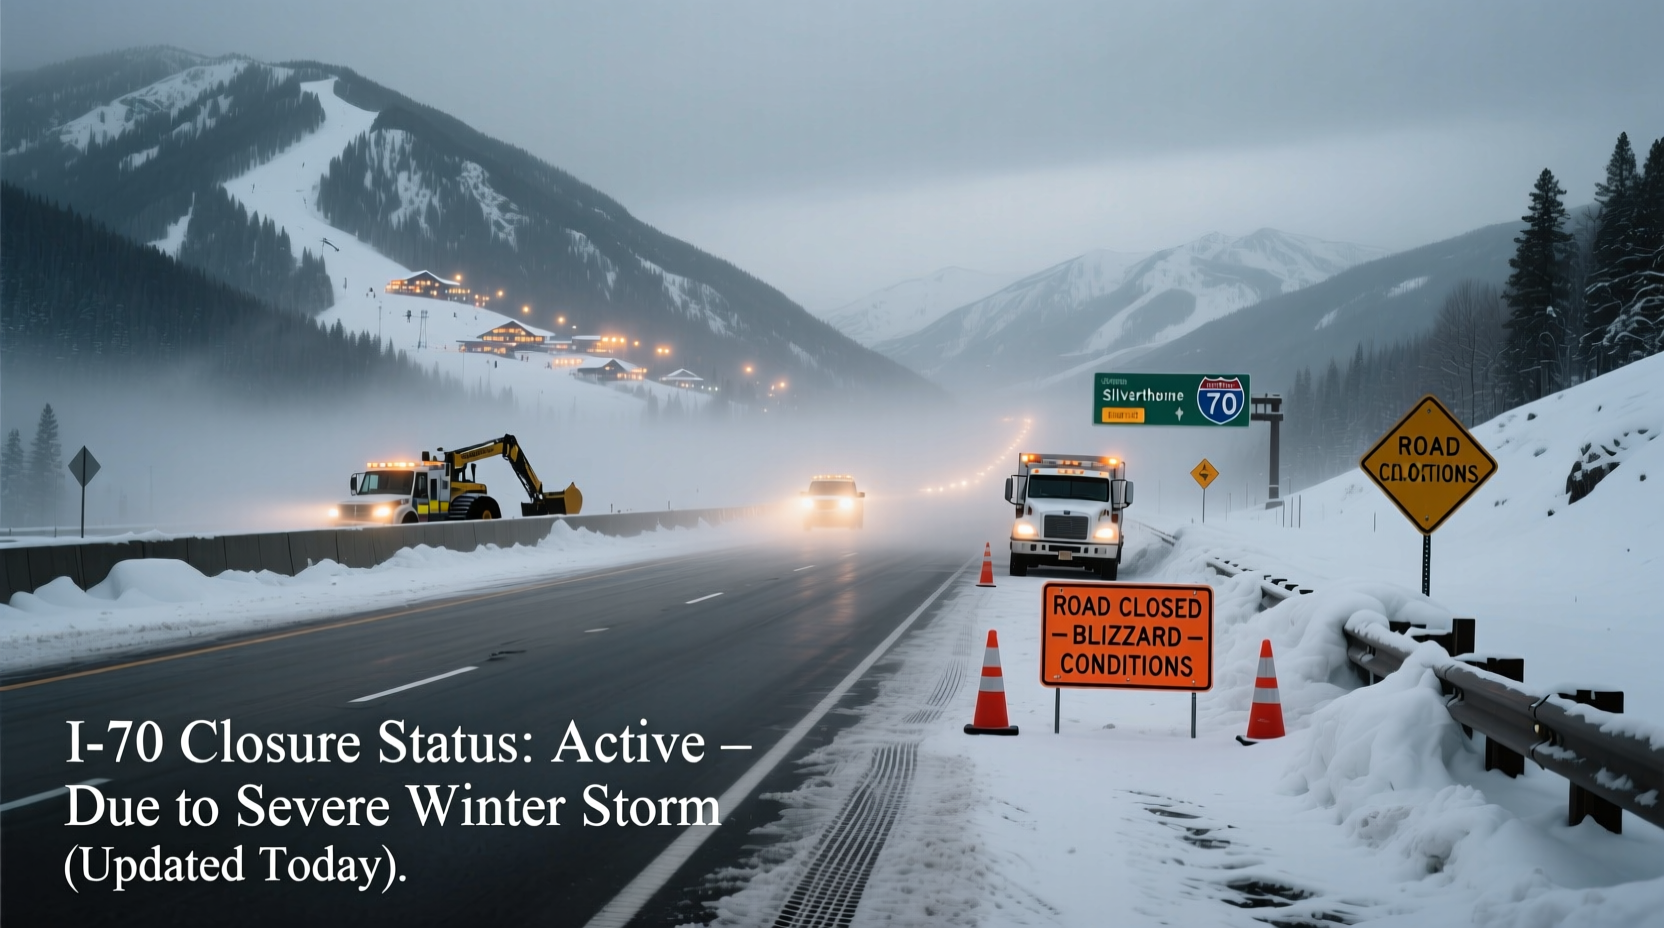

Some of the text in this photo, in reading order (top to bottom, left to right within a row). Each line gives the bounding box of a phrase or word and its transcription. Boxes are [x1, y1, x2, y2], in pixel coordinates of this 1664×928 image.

[1206, 392, 1237, 416] 70
[1398, 436, 1460, 456] ROAD
[1053, 594, 1202, 619] ROAD CLOSED
[1073, 624, 1182, 647] BLIZZARD
[1060, 652, 1193, 678] CONDITIONS
